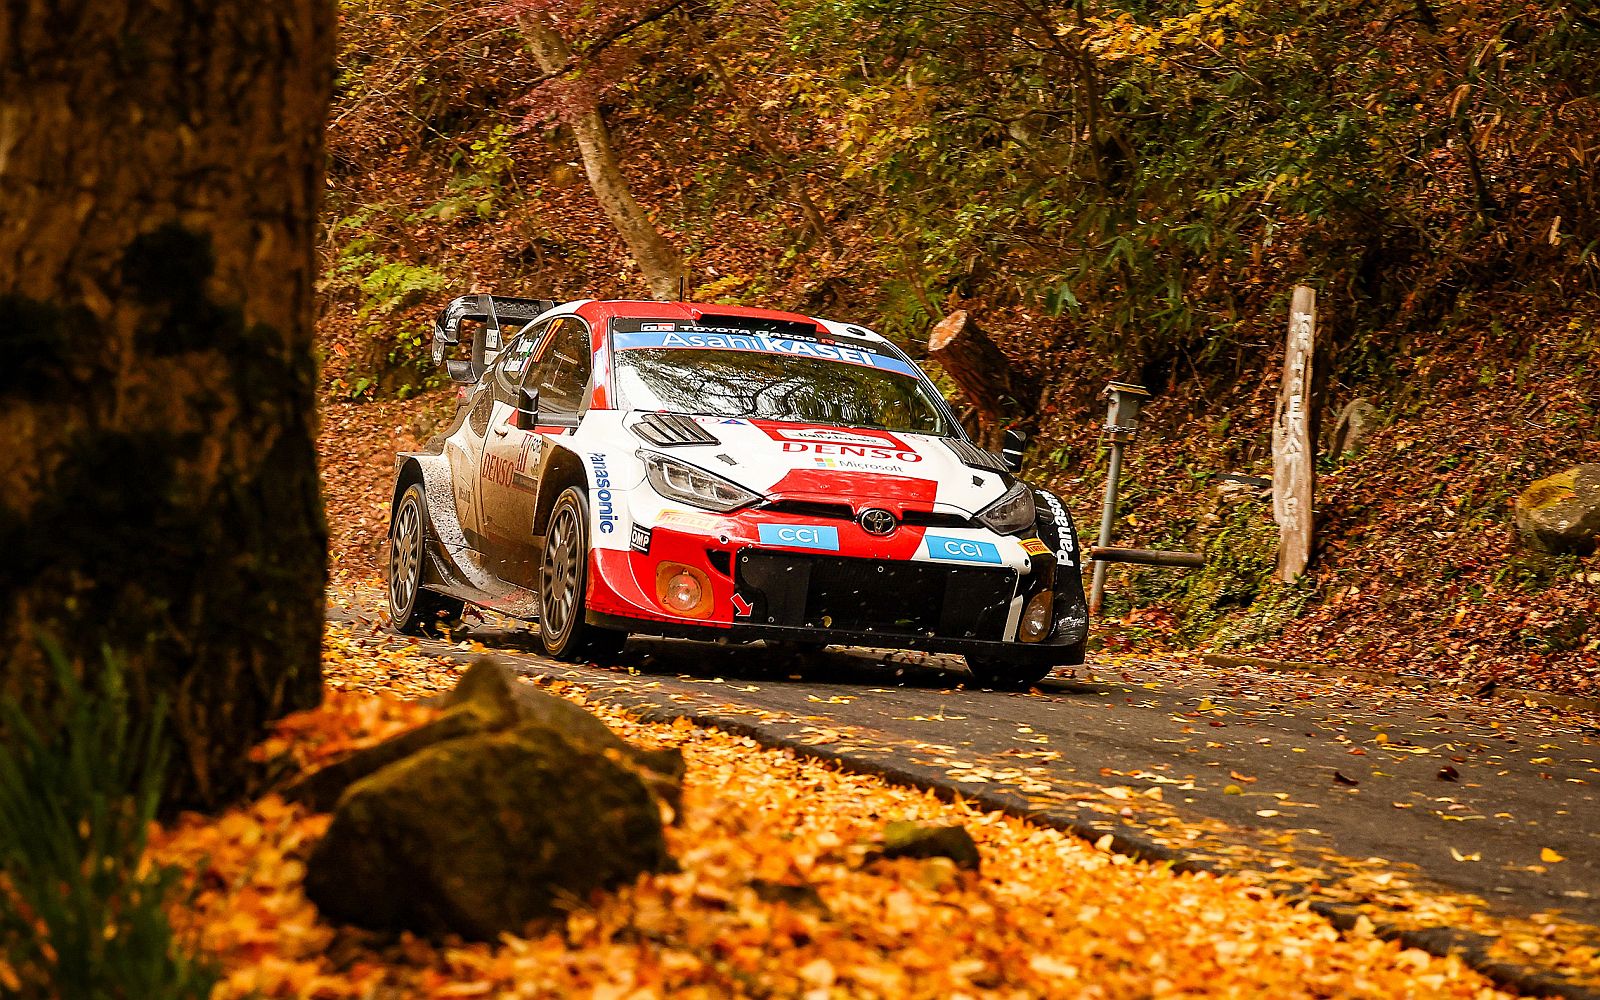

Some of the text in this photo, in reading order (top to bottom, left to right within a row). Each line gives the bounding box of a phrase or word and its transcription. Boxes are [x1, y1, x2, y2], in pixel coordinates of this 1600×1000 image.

[680, 325, 751, 335] TOYOTA
[782, 442, 923, 463] DENSO
[482, 452, 515, 487] DENSO
[839, 460, 904, 473] Microsoft
[631, 530, 650, 547] OMP
